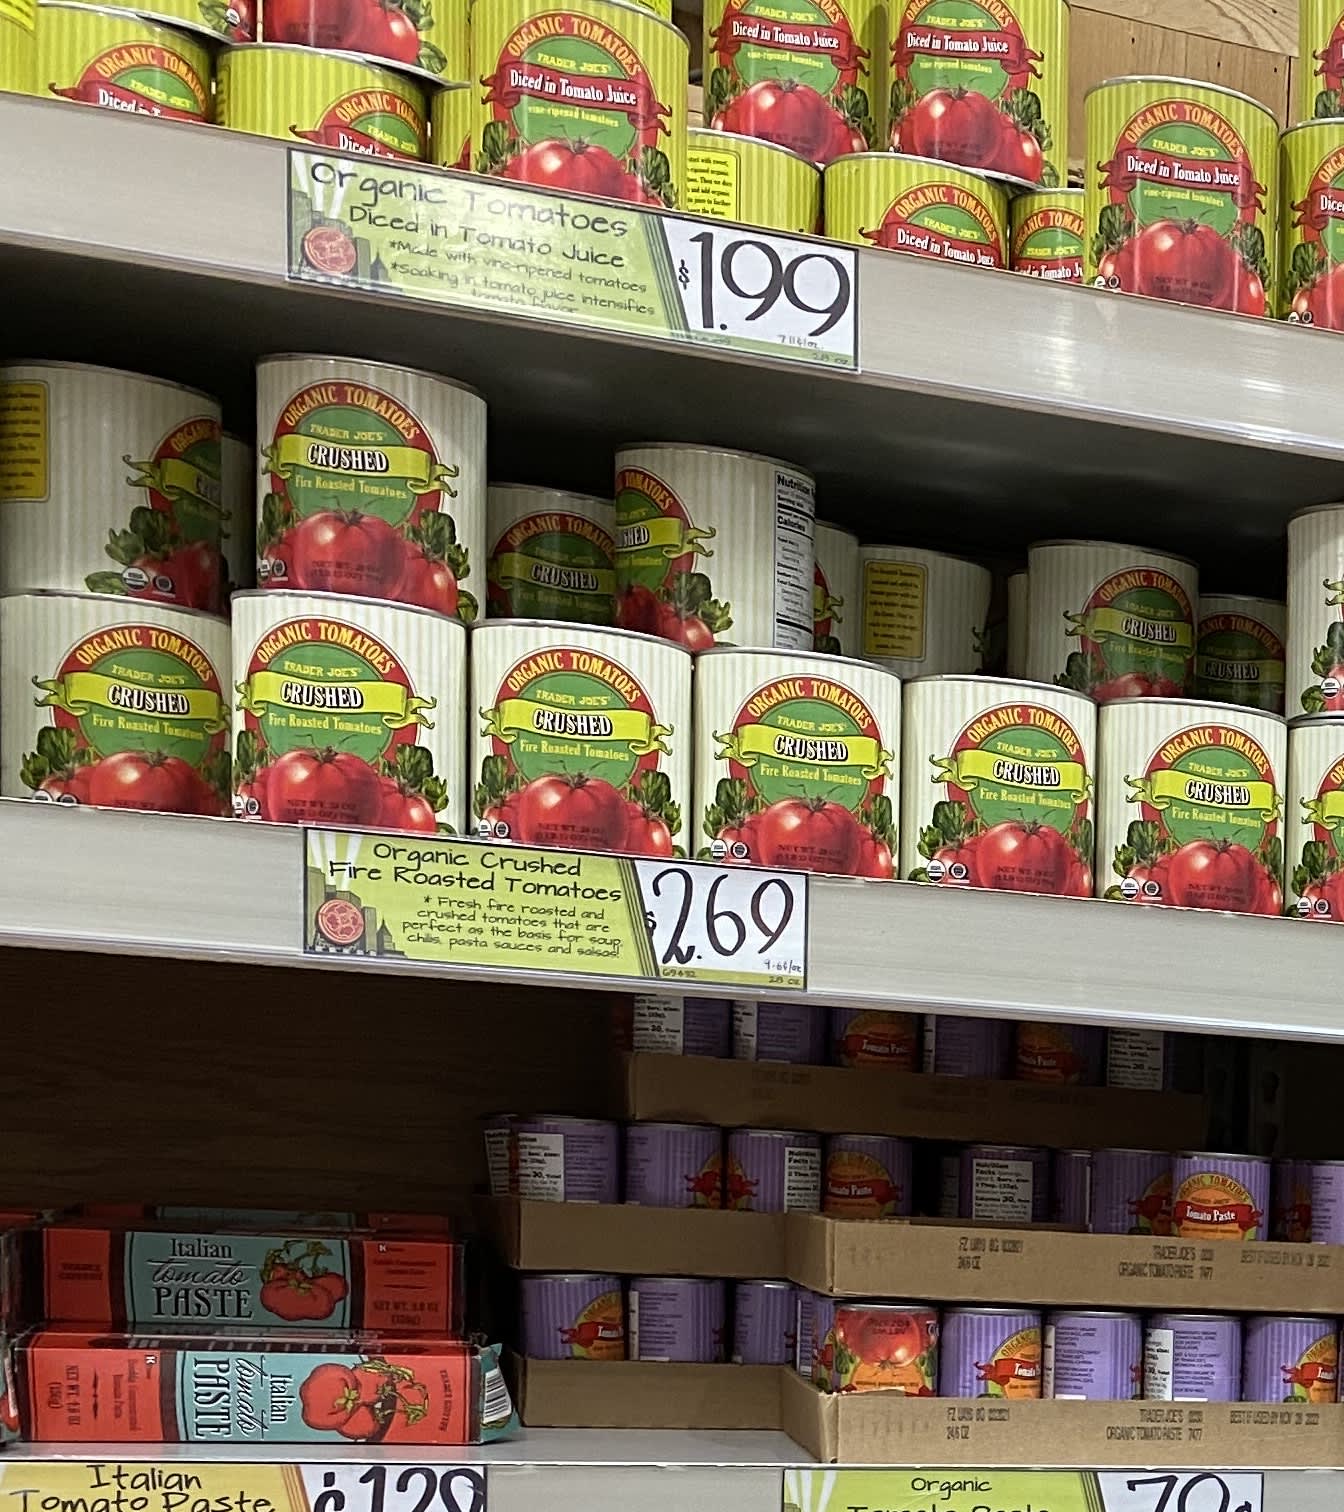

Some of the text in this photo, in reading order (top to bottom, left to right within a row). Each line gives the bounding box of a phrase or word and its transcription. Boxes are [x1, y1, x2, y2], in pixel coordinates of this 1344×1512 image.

[508, 12, 642, 77] ORGANIC TOMATOES
[510, 68, 637, 105] Diced in Tomato Juice
[311, 161, 628, 239] Organic Tomatoes
[349, 206, 625, 269] Diced in Tomato Juice
[678, 231, 852, 336] $1.99
[280, 680, 363, 711] CRUSHED
[373, 841, 582, 877] Organic Crushed
[328, 860, 622, 902] Fire Roasted Tomatoes
[417, 908, 549, 928] crushed tomatoes
[437, 896, 576, 919] Fresh roasted
[645, 867, 796, 966] $2.69
[1185, 1204, 1236, 1224] Tomato Paste
[170, 1238, 232, 1260] Italian
[152, 1286, 253, 1322] PASTE
[89, 1463, 202, 1491] Italian
[911, 1476, 992, 1501] Organic
